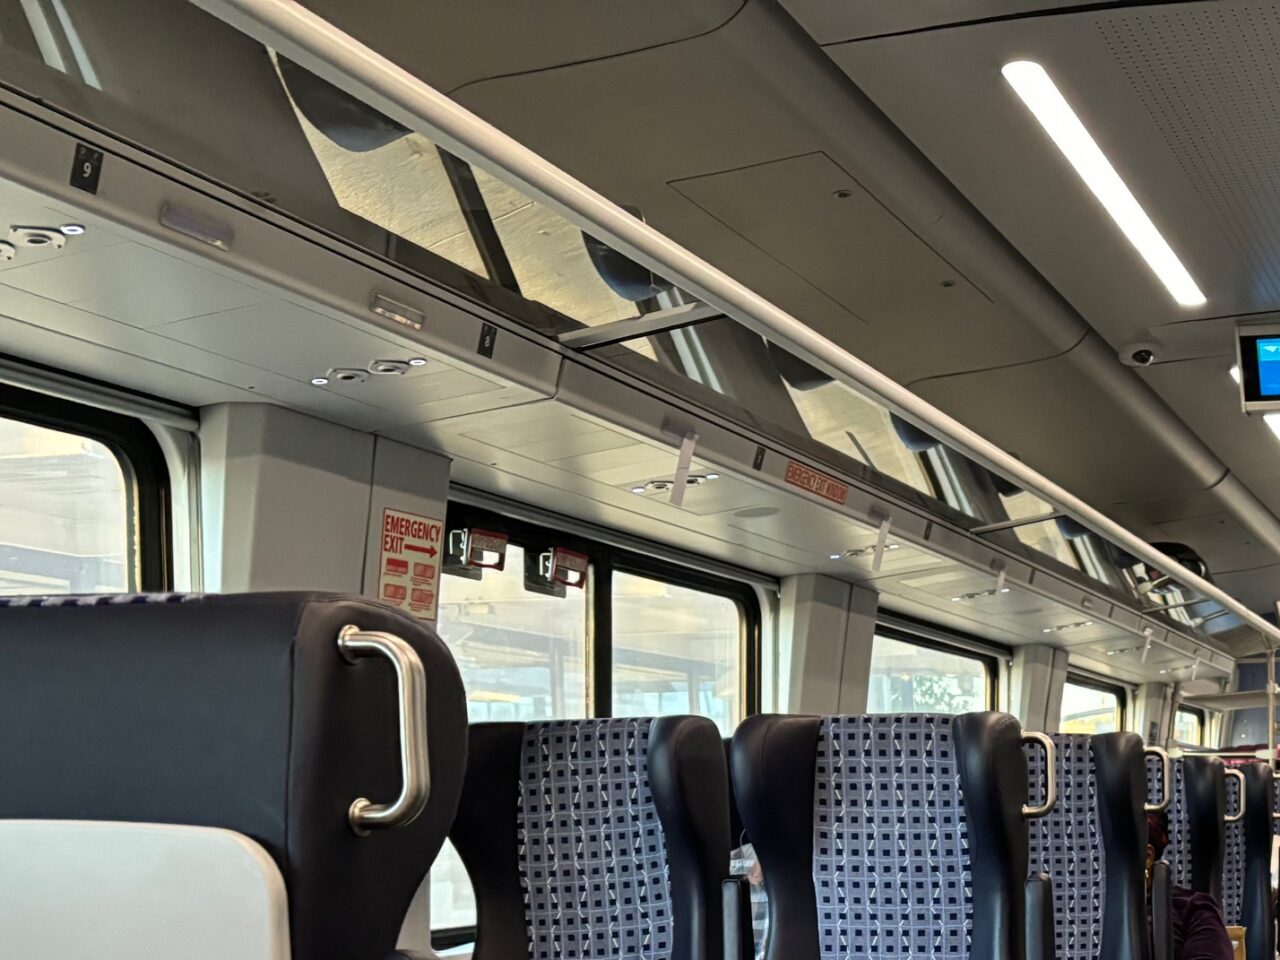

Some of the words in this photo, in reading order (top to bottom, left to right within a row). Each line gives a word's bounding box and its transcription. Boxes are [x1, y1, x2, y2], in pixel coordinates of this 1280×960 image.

[82, 162, 92, 178] 9
[385, 514, 441, 543] EMERGENCY
[384, 534, 404, 554] EXIT
